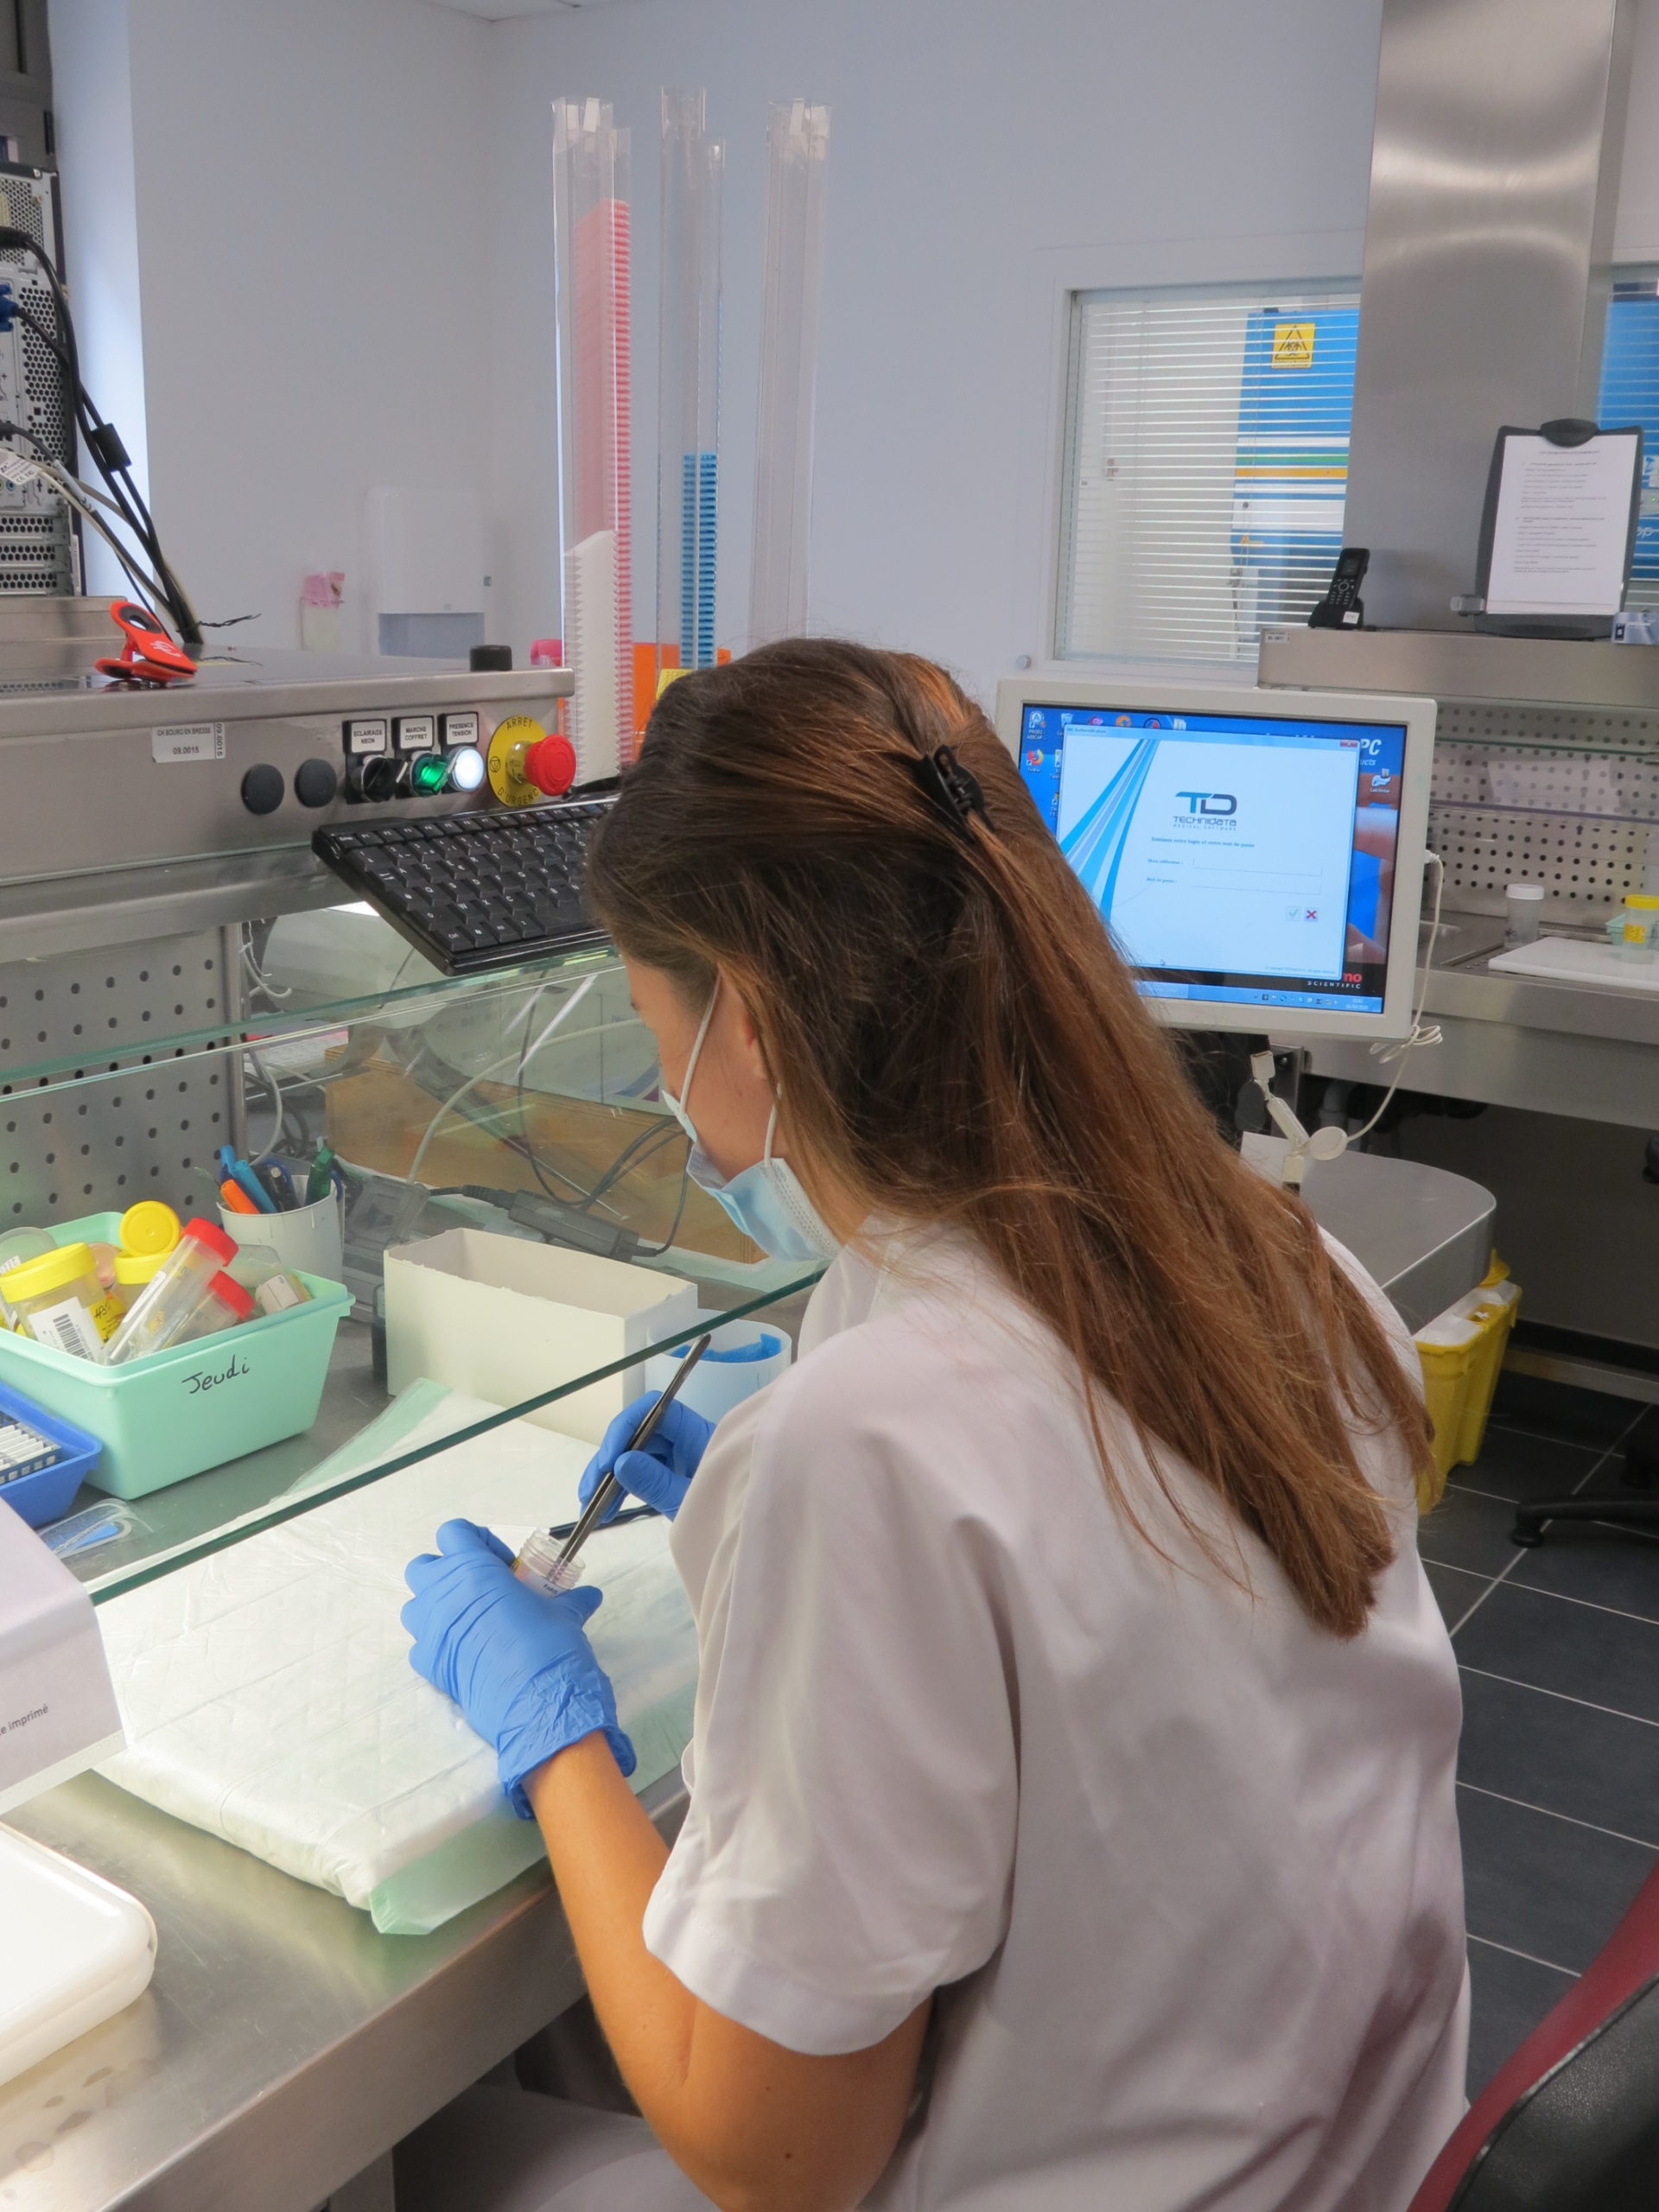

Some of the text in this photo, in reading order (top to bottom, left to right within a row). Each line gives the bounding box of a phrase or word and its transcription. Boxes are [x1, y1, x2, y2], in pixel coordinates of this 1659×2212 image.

[506, 716, 533, 730] ARRET
[173, 747, 200, 755] 09.0015
[1360, 739, 1382, 756] PC
[498, 786, 540, 806] D'URGENC
[1307, 981, 1361, 989] SCIENTIFIC
[181, 1354, 251, 1394] Jeudi
[8, 1702, 49, 1730] imprimé
